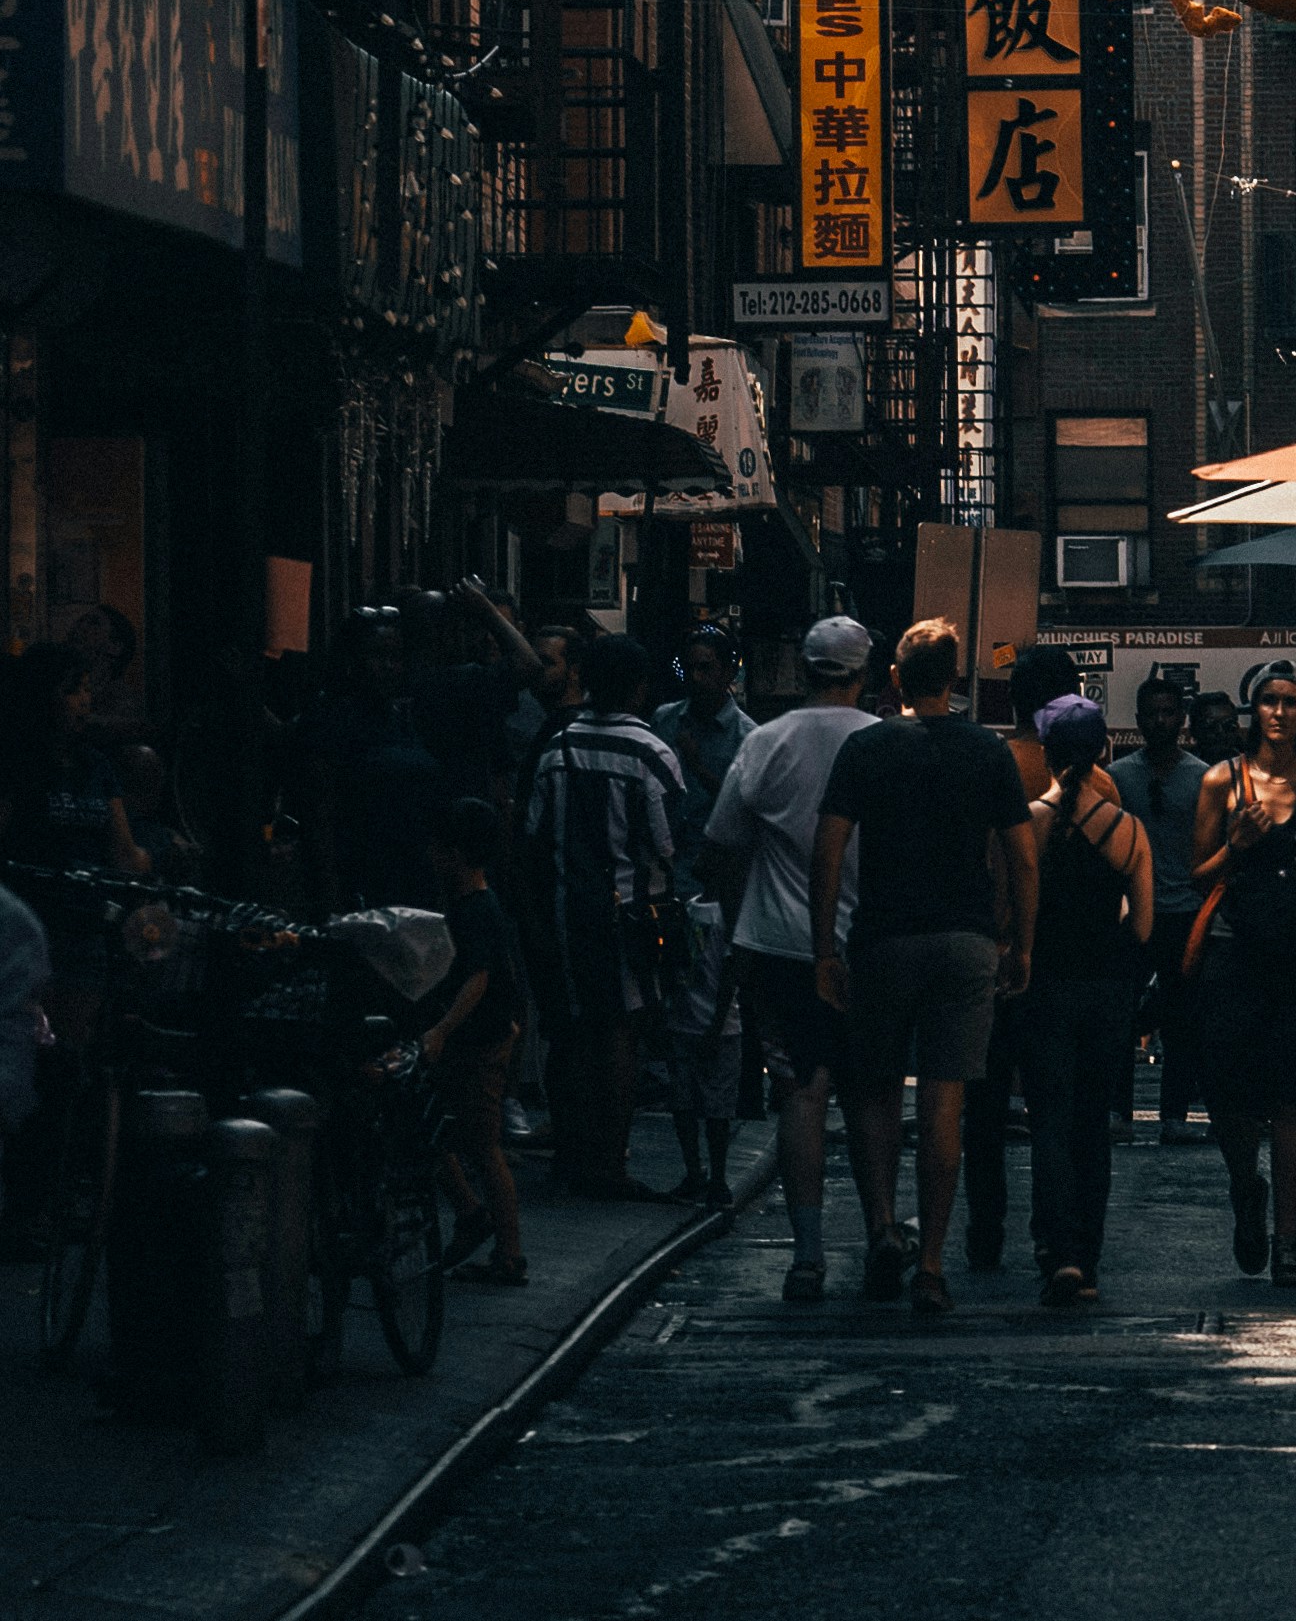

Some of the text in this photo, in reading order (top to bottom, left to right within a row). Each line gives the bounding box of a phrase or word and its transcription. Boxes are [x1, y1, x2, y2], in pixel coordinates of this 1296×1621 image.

[812, 51, 871, 260] 中華拉麵
[626, 373, 643, 390] St
[1125, 632, 1204, 645] PARADISE
[1260, 631, 1282, 645] AJI
[1075, 651, 1102, 664] WAY
